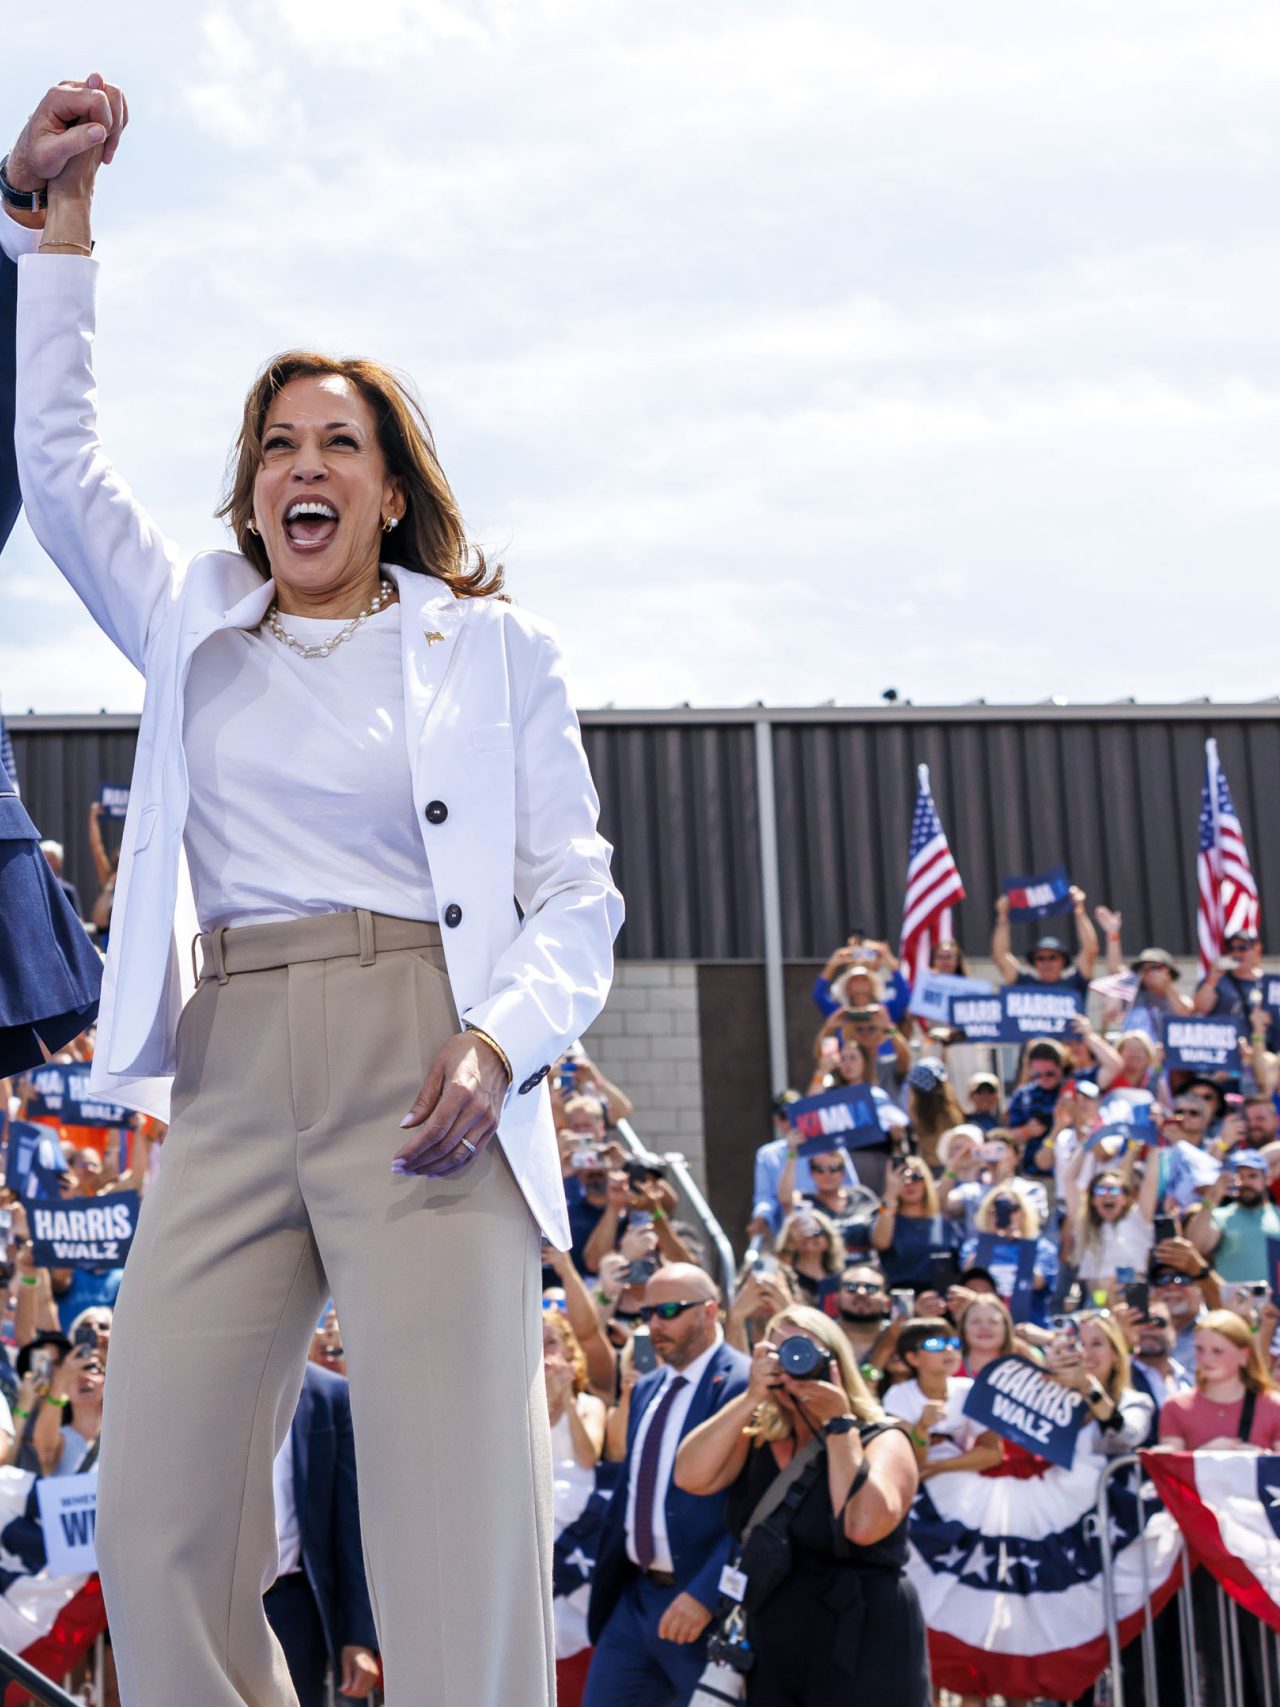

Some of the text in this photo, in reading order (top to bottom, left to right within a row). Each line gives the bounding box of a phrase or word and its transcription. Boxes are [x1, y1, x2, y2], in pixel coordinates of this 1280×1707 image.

[1006, 992, 1076, 1018] HARRIS
[1018, 1017, 1066, 1032] WALZ
[1167, 1022, 1237, 1050] HARRIS
[1179, 1048, 1228, 1065] WALZ
[80, 1103, 125, 1122] WALZ
[33, 1203, 132, 1242] HARRIS
[52, 1241, 119, 1259] WALZ
[986, 1358, 1083, 1428] HARRIS
[991, 1393, 1055, 1445] WALZ
